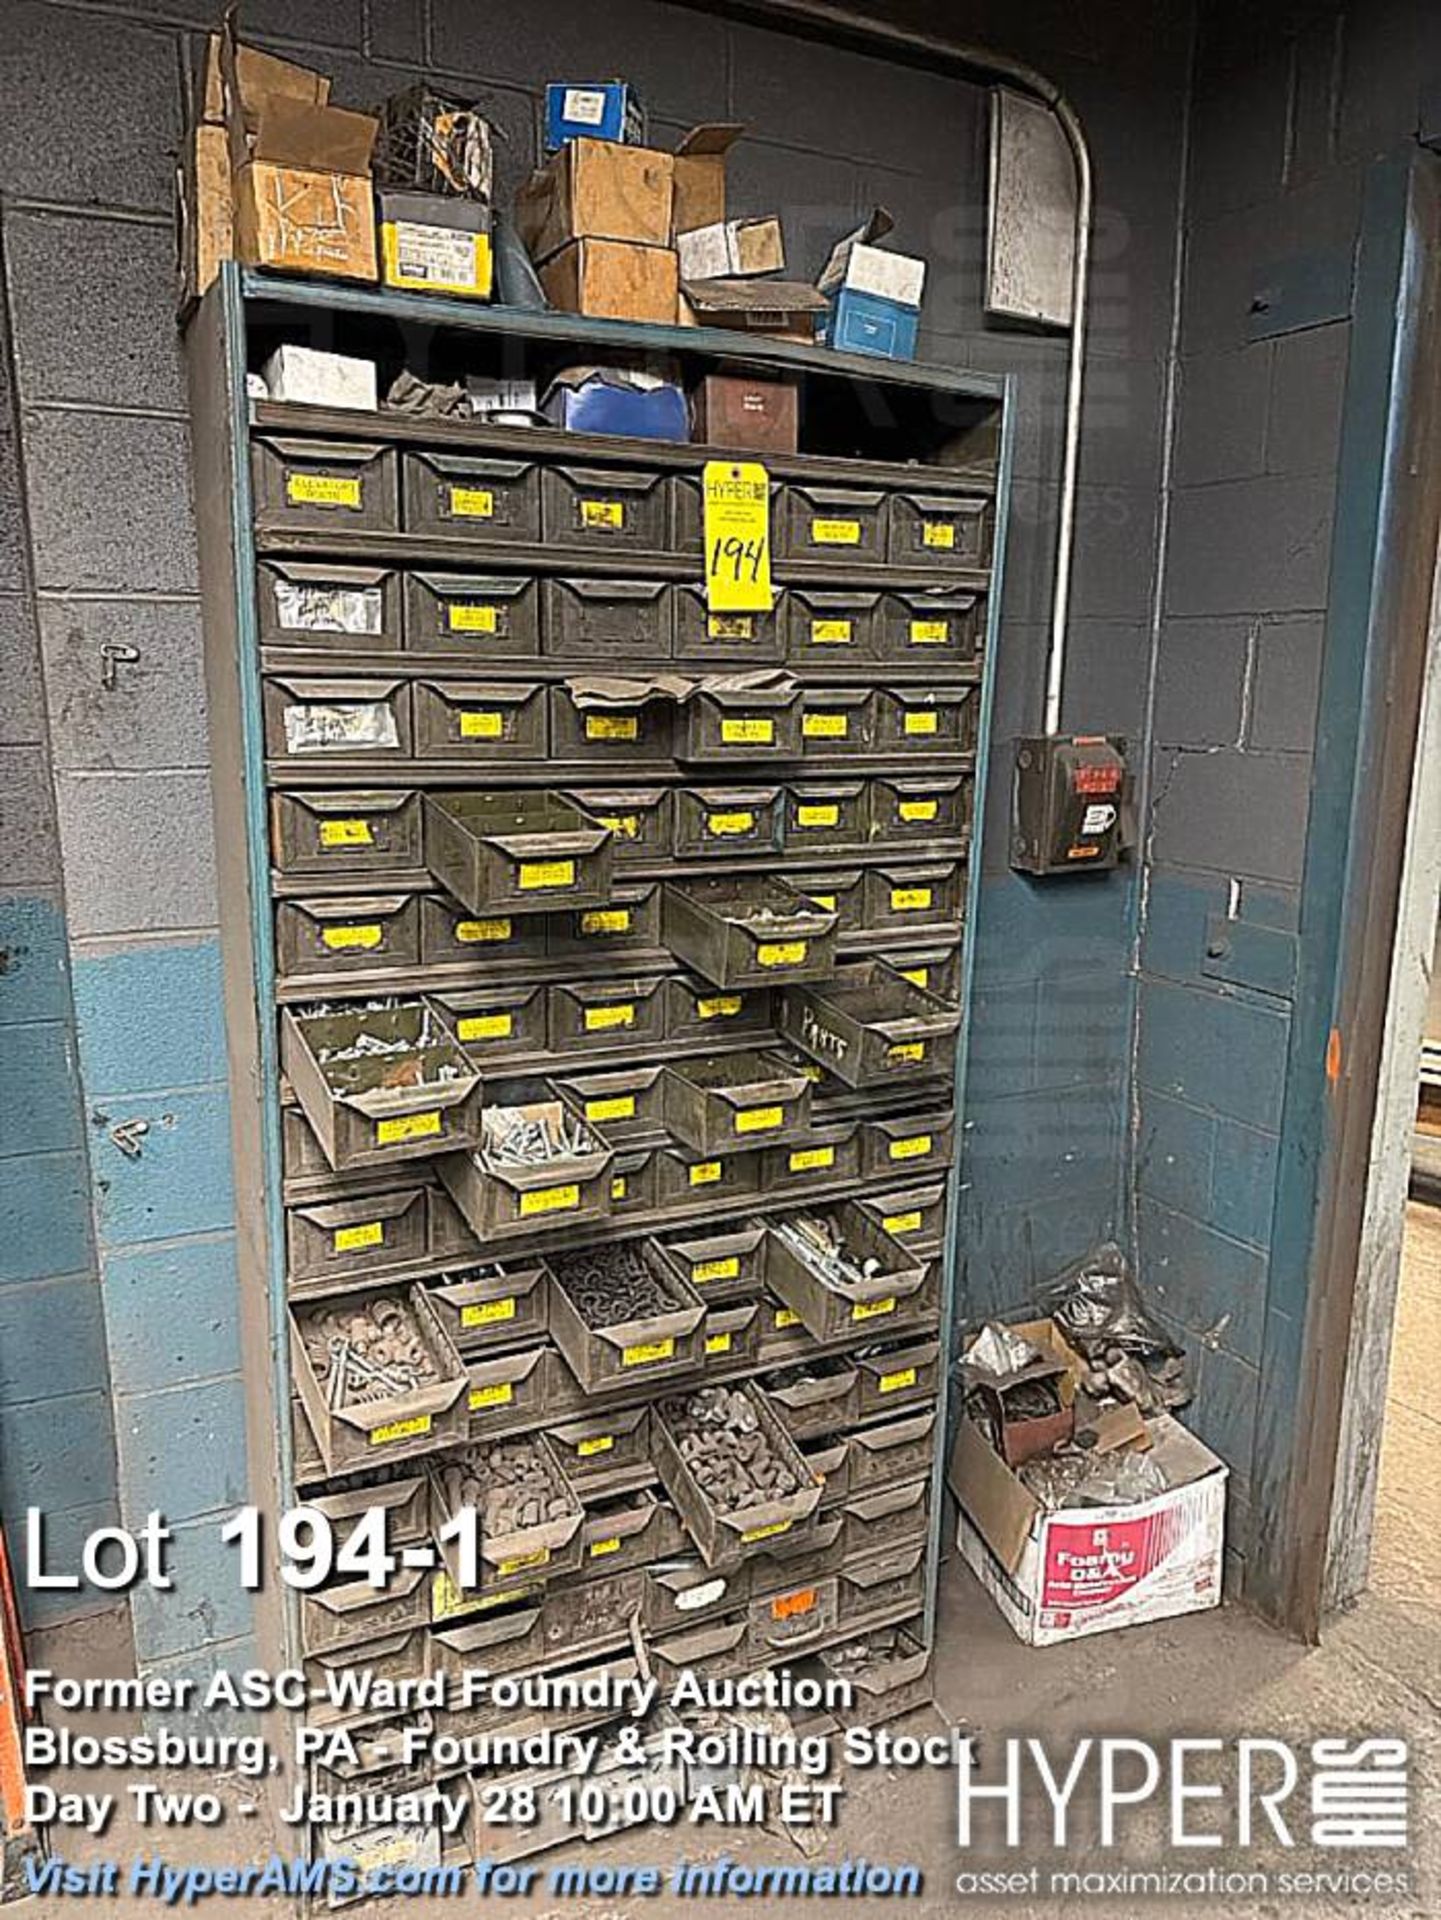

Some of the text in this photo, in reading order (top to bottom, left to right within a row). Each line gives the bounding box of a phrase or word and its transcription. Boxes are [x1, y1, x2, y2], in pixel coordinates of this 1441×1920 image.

[707, 481, 751, 500] HYPER
[711, 536, 765, 583] 194
[1057, 1550, 1135, 1567] Foamy
